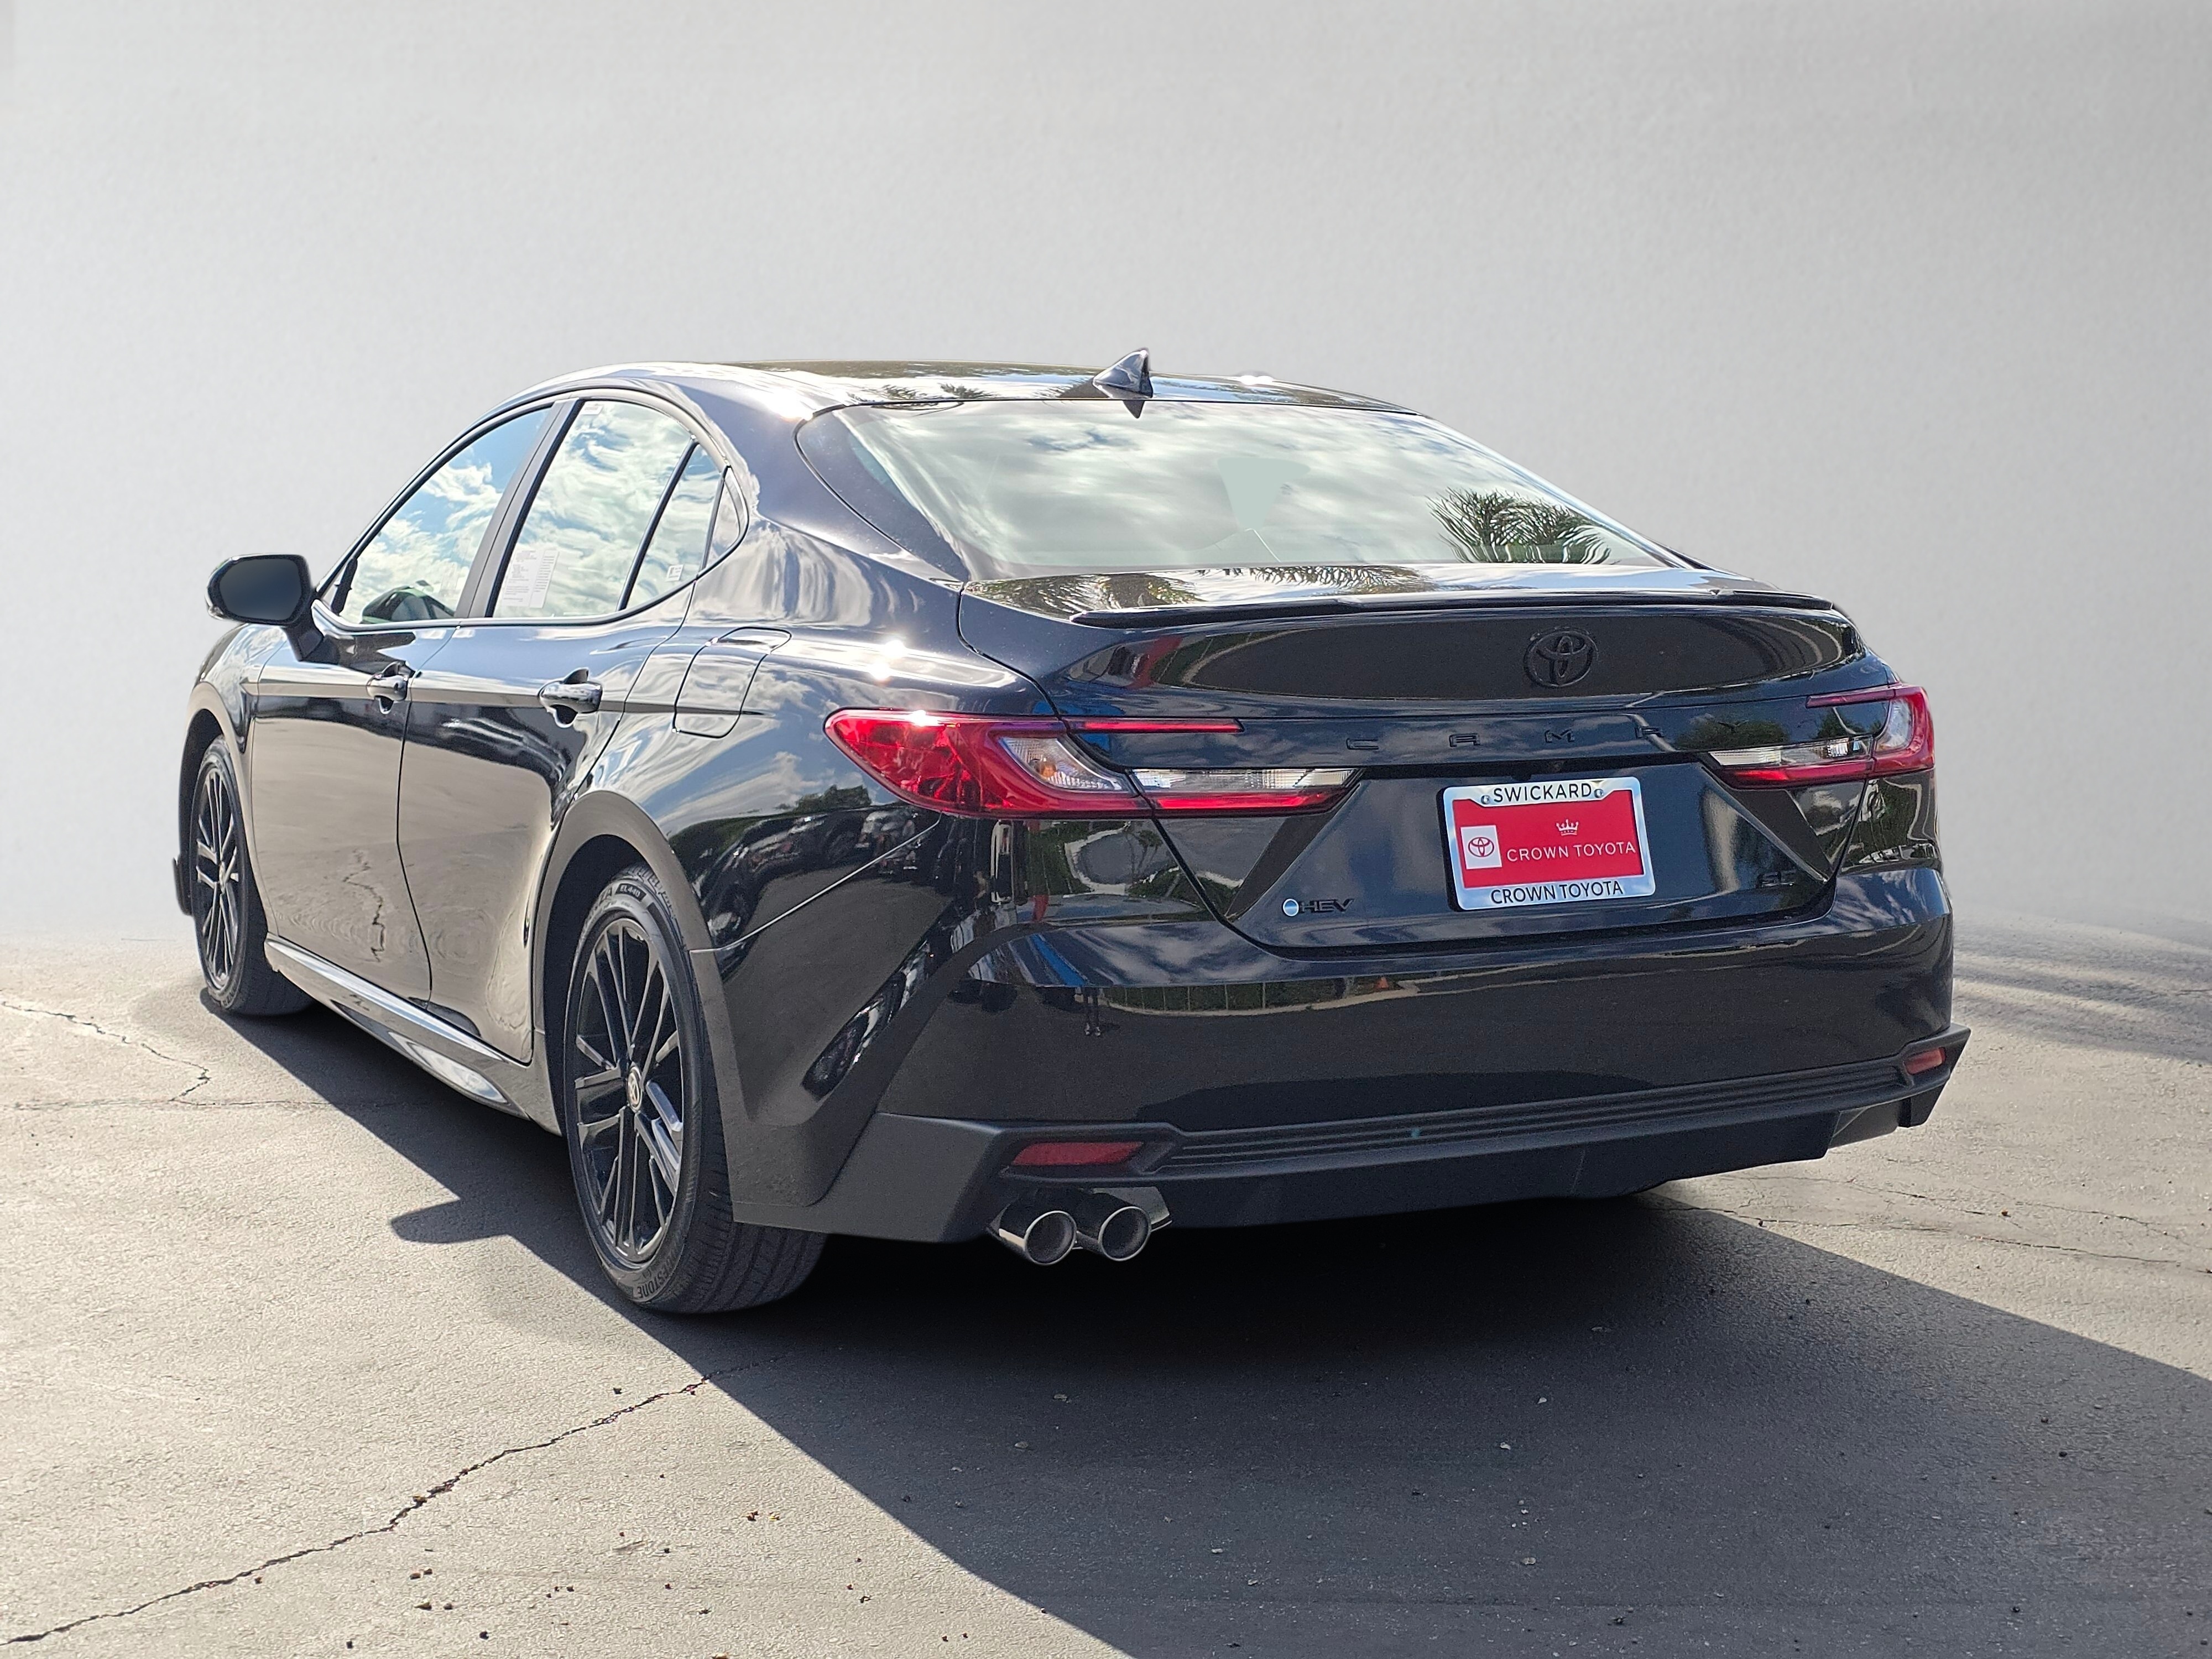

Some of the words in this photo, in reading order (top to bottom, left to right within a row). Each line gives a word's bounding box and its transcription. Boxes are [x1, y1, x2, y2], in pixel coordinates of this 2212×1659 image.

[1345, 719, 1749, 750] CAMRY
[1493, 782, 1592, 803] SWICKARD
[1507, 846, 1569, 862] CROWN
[1573, 841, 1635, 857] TOYOTA
[1490, 884, 1556, 904] CROWN
[1559, 880, 1623, 899] TOYOTA
[1299, 898, 1354, 914] HEV
